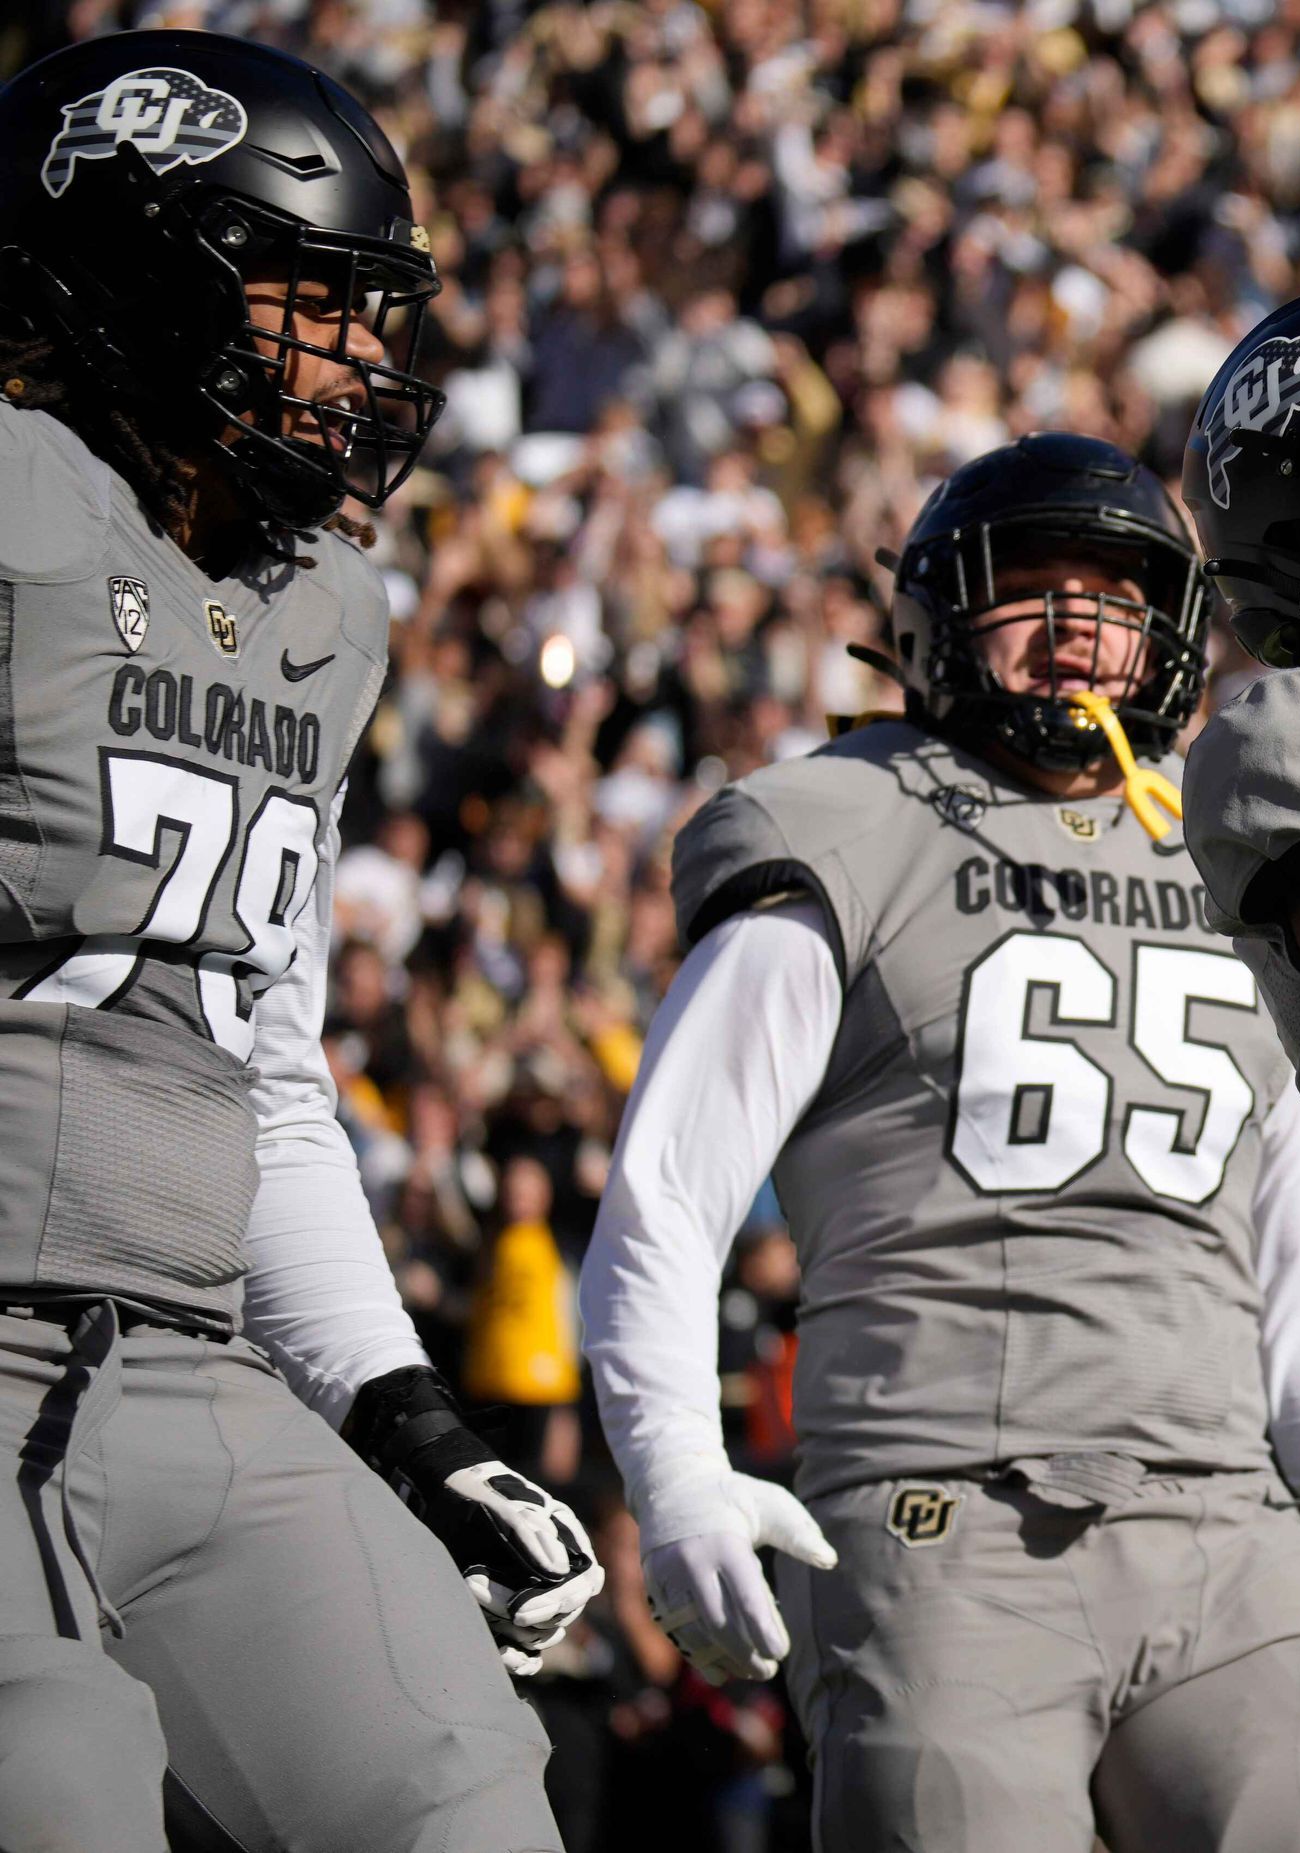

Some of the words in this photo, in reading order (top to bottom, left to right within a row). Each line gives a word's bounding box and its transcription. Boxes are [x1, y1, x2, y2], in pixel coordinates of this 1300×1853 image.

[108, 663, 320, 785] COLORADO
[943, 928, 1258, 1206] 65
[891, 1487, 957, 1542] CU
